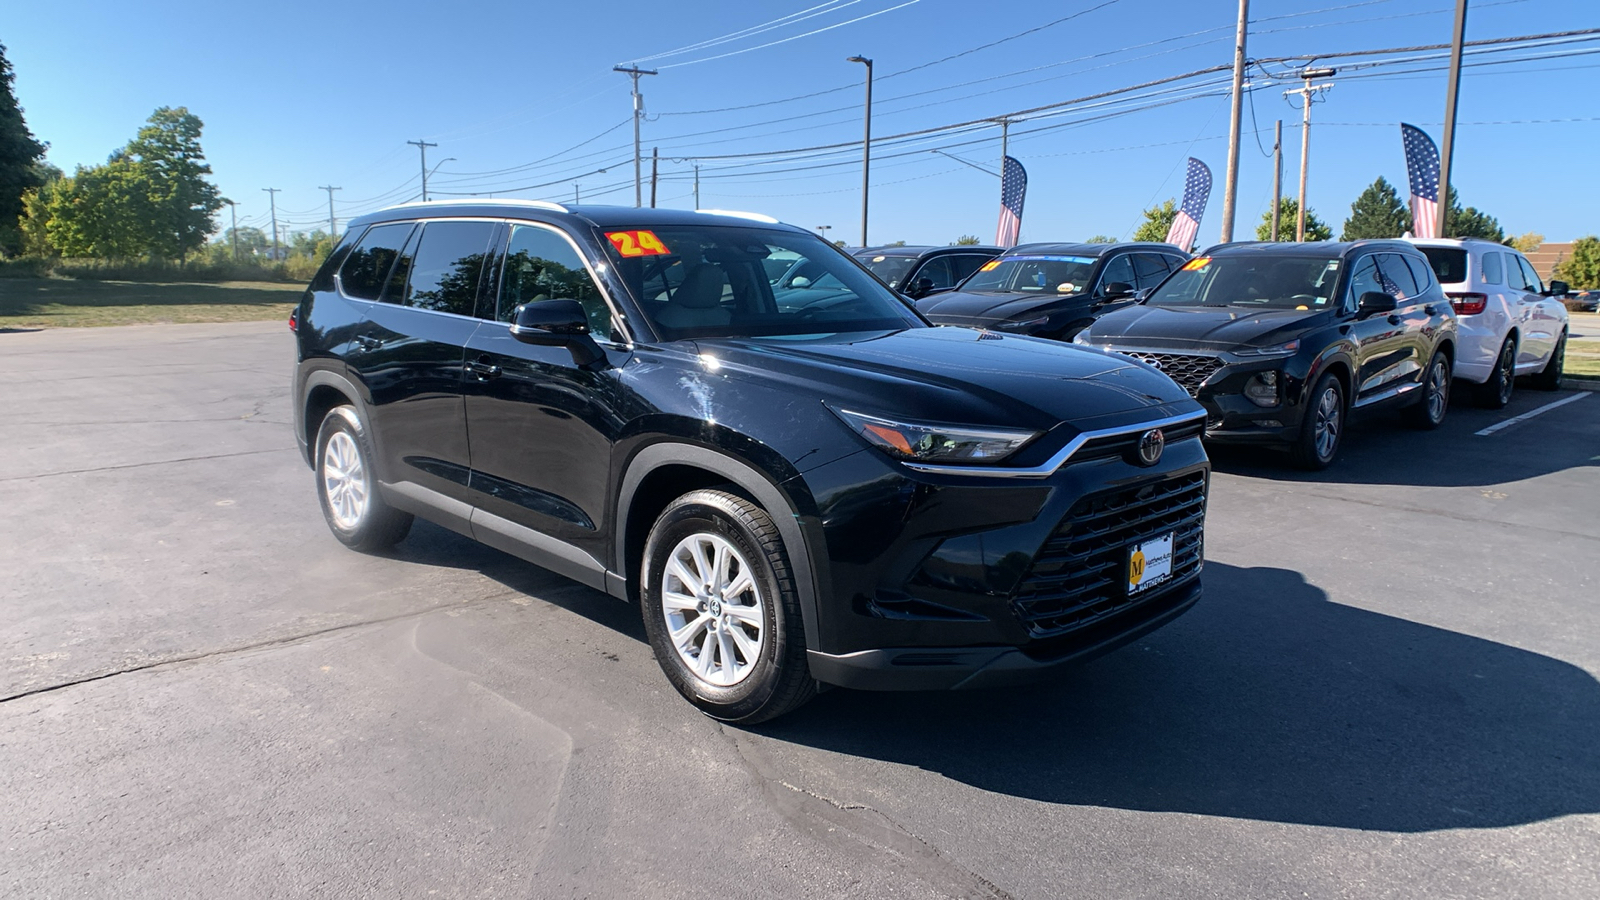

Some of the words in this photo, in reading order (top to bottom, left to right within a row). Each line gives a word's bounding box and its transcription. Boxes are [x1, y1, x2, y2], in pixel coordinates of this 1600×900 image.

[609, 231, 667, 255] 24
[1131, 558, 1142, 578] M
[1139, 576, 1164, 591] MATTHEWS
